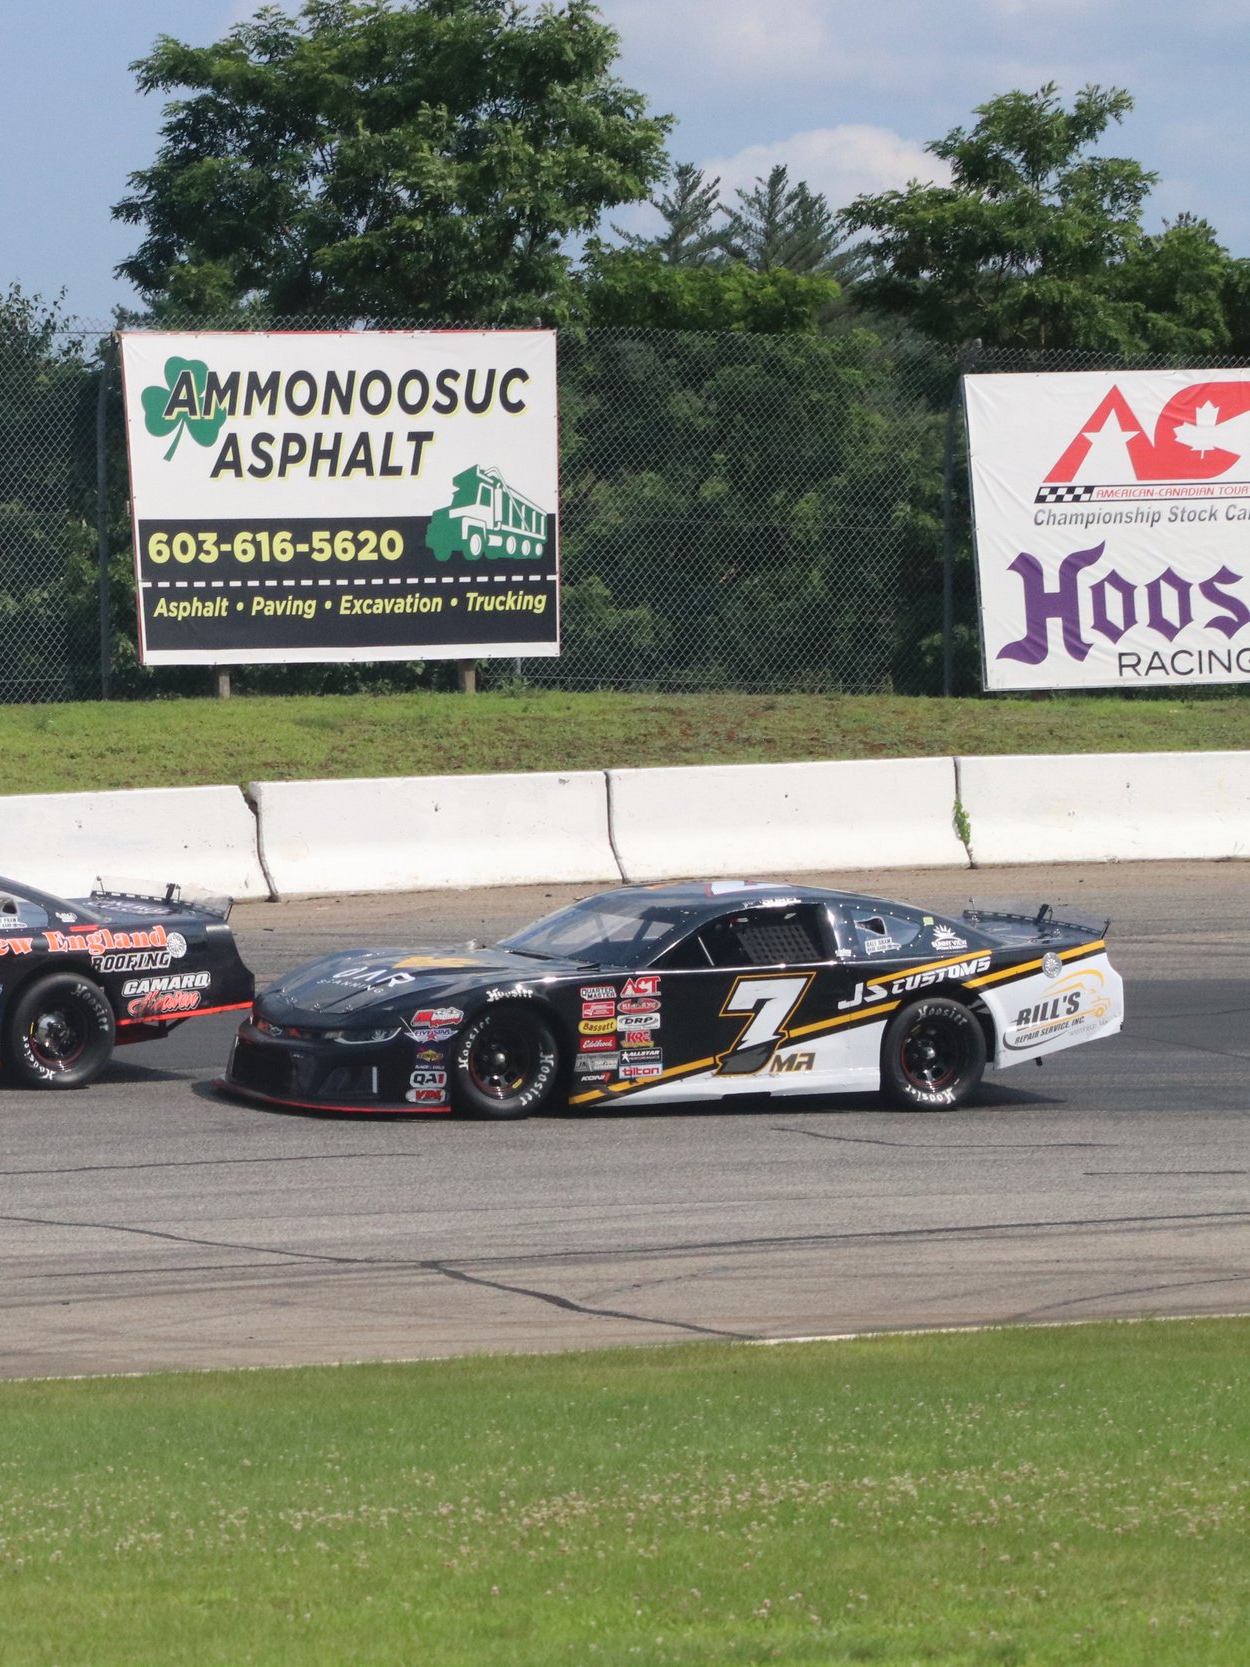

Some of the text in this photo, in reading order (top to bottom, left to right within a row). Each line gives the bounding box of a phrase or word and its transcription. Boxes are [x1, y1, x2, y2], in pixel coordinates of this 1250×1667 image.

[163, 367, 531, 419] AMMONOOSUC
[210, 431, 435, 480] ASPHALT
[1096, 486, 1249, 499] AMERICAN-CANADIAN TOUR
[1034, 507, 1162, 529] Championship
[1168, 505, 1219, 523] Stock
[148, 530, 404, 563] 603-616-5620
[154, 592, 546, 621] Asphalt Paving Excavation Trucking
[42, 925, 168, 956] England
[91, 951, 171, 973] ROOFING
[123, 972, 209, 996] CAMARO
[621, 976, 661, 995] ACT
[837, 956, 992, 1010] JS CUSTOMS
[70, 983, 109, 1032] Hoosier
[582, 1021, 614, 1031] Bassett
[624, 1016, 653, 1024] DRP
[720, 973, 815, 1074] 7
[458, 1017, 490, 1071] Hoosier
[626, 1031, 650, 1043] KRC
[1014, 1031, 1039, 1044] REPAIR
[621, 1066, 660, 1076] tilton
[770, 1052, 816, 1073] MA
[413, 1073, 445, 1085] QA1
[519, 1051, 554, 1106] Hoosier
